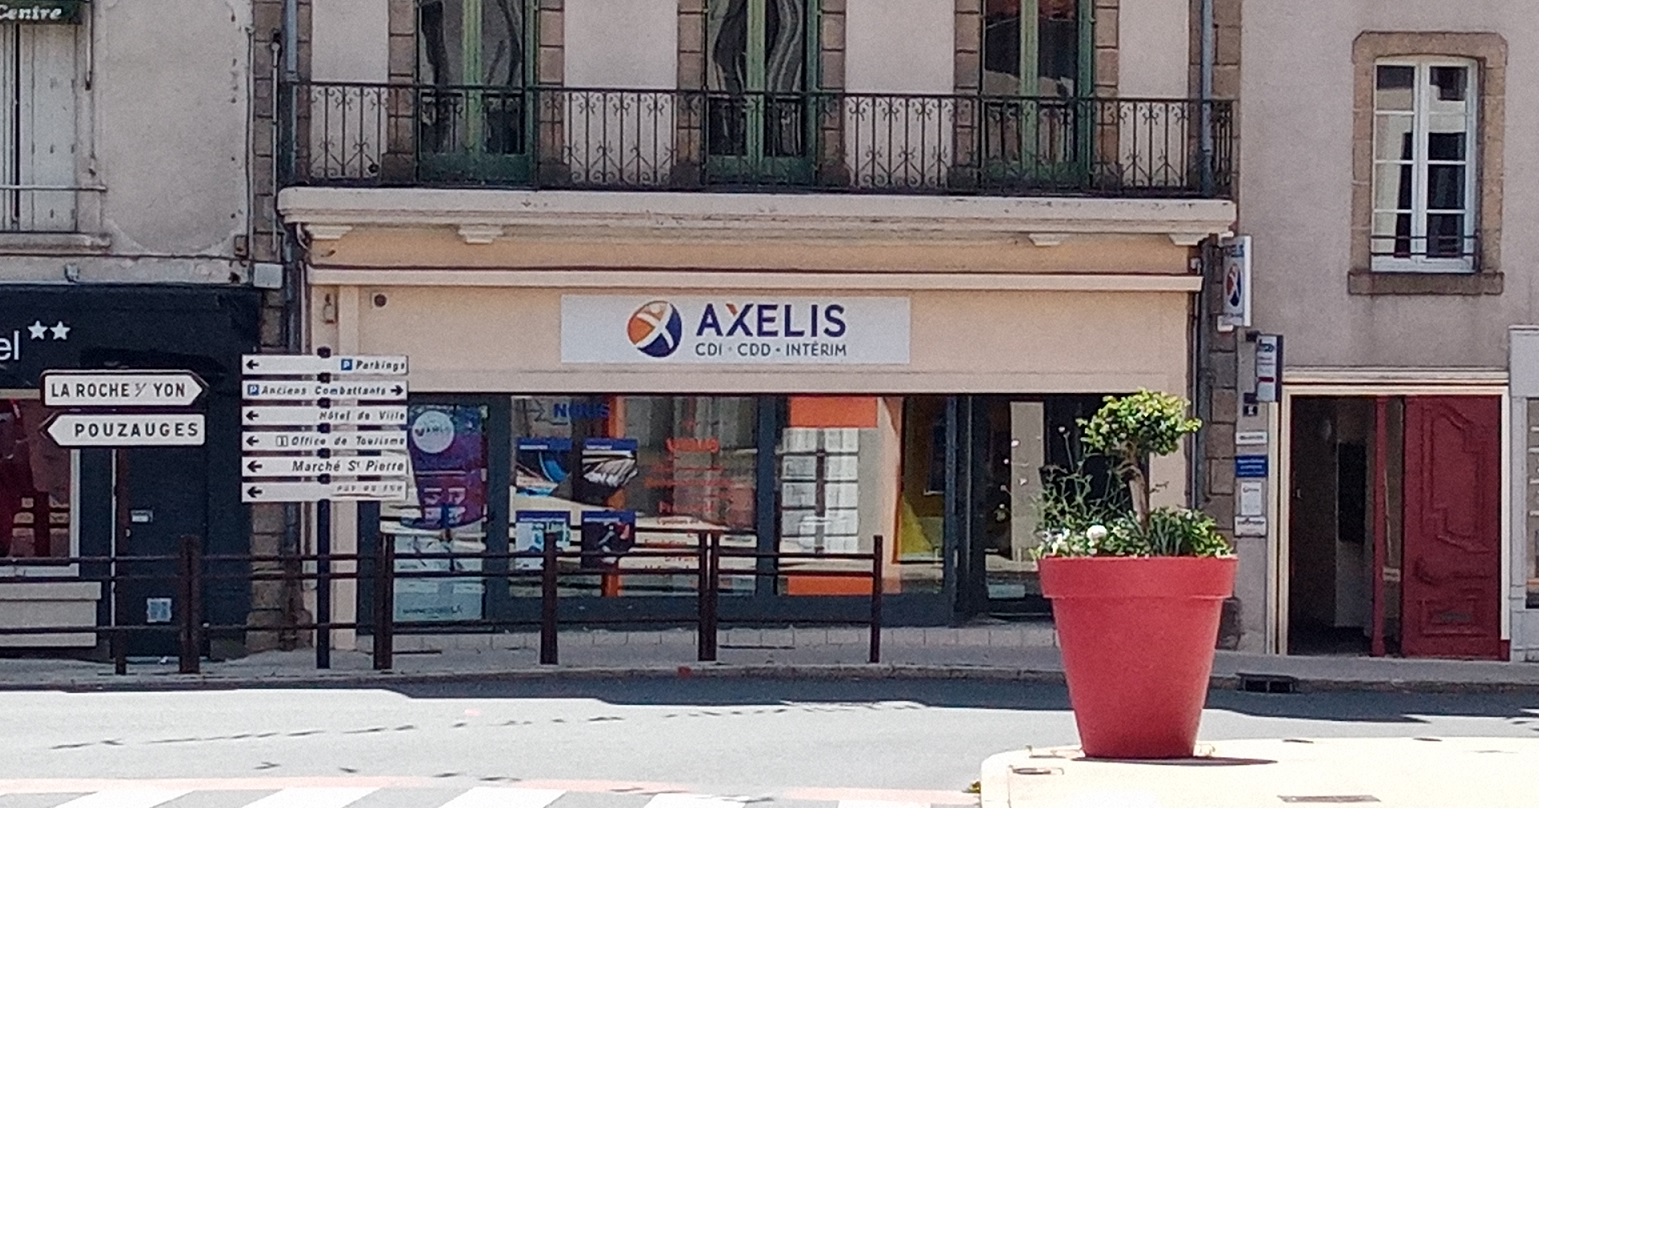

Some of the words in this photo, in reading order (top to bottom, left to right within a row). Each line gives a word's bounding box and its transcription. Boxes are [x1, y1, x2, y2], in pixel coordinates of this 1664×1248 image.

[0, 4, 62, 20] Centre
[696, 303, 846, 338] AXELIS
[695, 342, 722, 356] CDI
[737, 342, 771, 356] CDD
[786, 341, 847, 357] INTÉRIM
[355, 360, 405, 372] Parkings
[51, 383, 70, 397] LA
[76, 383, 130, 397] ROCHE
[153, 383, 185, 397] YON
[261, 385, 307, 395] Anciens
[315, 385, 386, 395] Combattants
[319, 411, 351, 421] Hôtel
[357, 411, 370, 421] de
[379, 411, 405, 421] Ville
[74, 423, 198, 437] POUZAUGES
[291, 435, 326, 445] Office
[334, 435, 347, 445] de
[356, 435, 405, 445] Tourisme
[292, 459, 341, 472] Marché
[366, 460, 404, 472] Pierre
